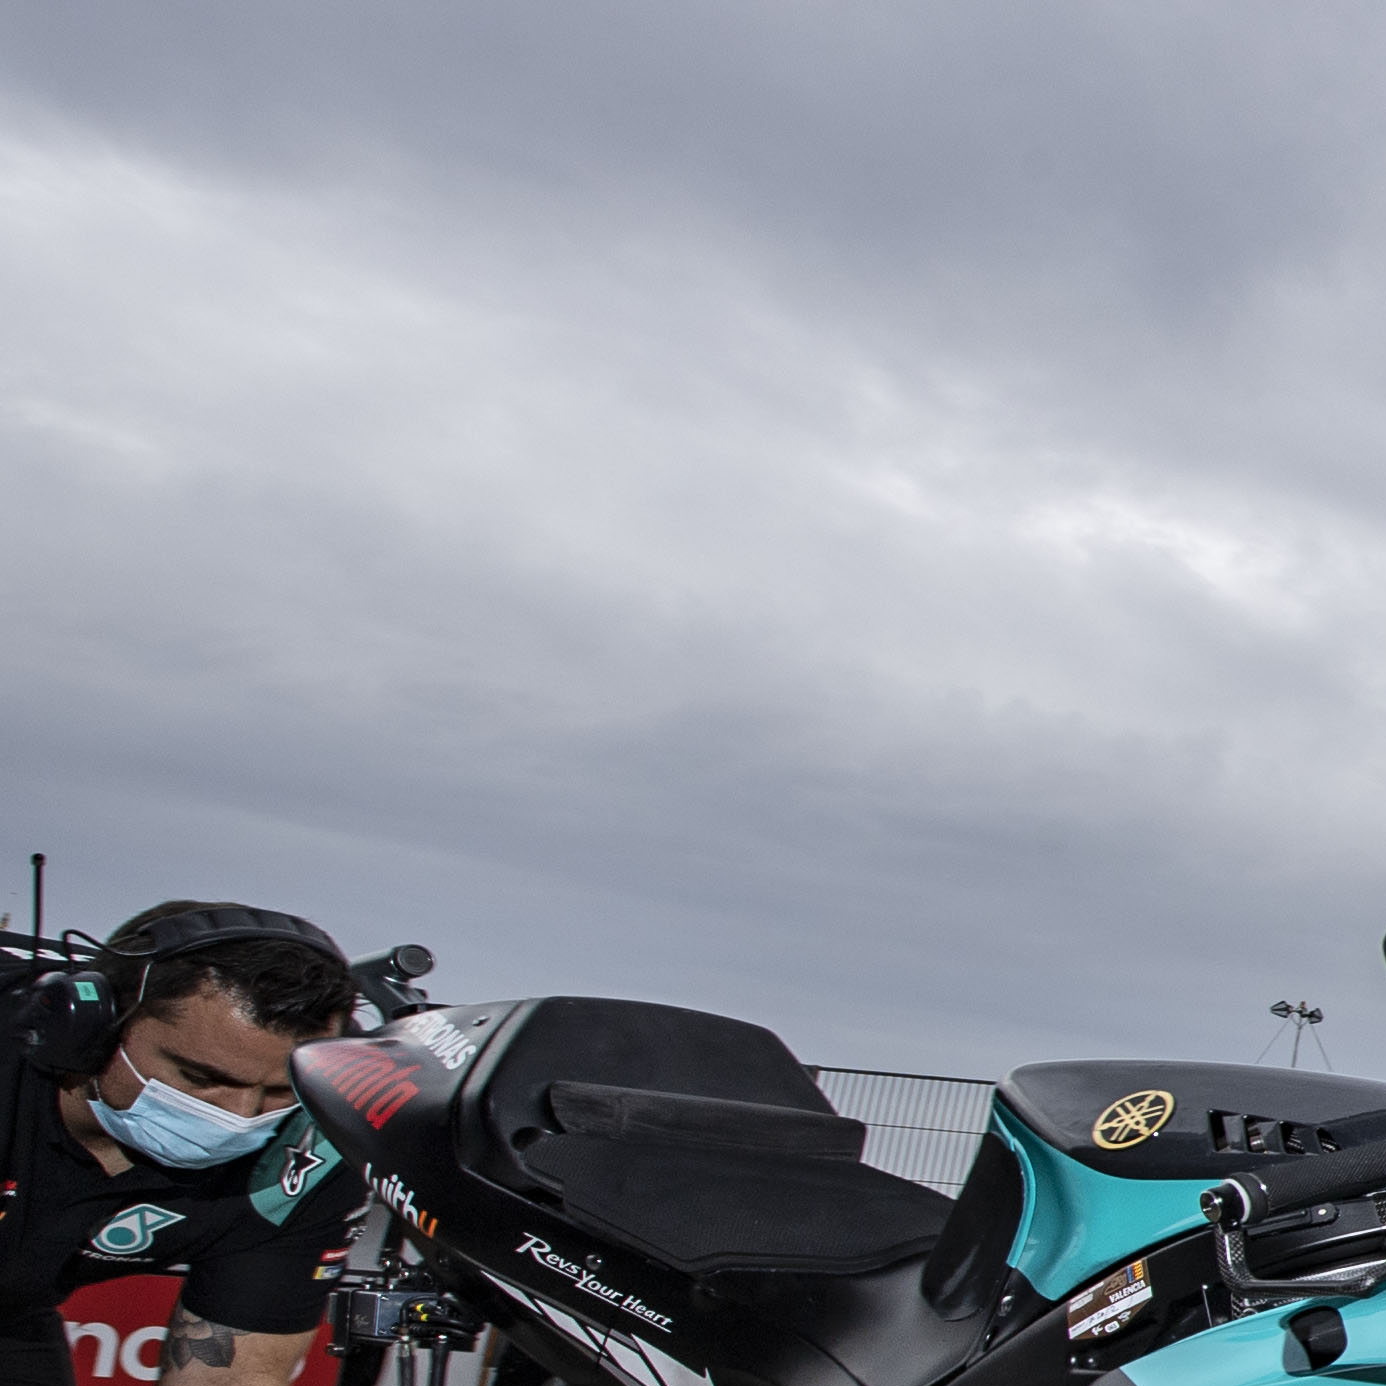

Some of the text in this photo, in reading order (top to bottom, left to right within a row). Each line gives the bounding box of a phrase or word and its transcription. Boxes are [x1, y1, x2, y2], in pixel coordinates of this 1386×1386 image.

[80, 1249, 156, 1263] TRONA
[514, 1231, 674, 1333] Revs Your Heart
